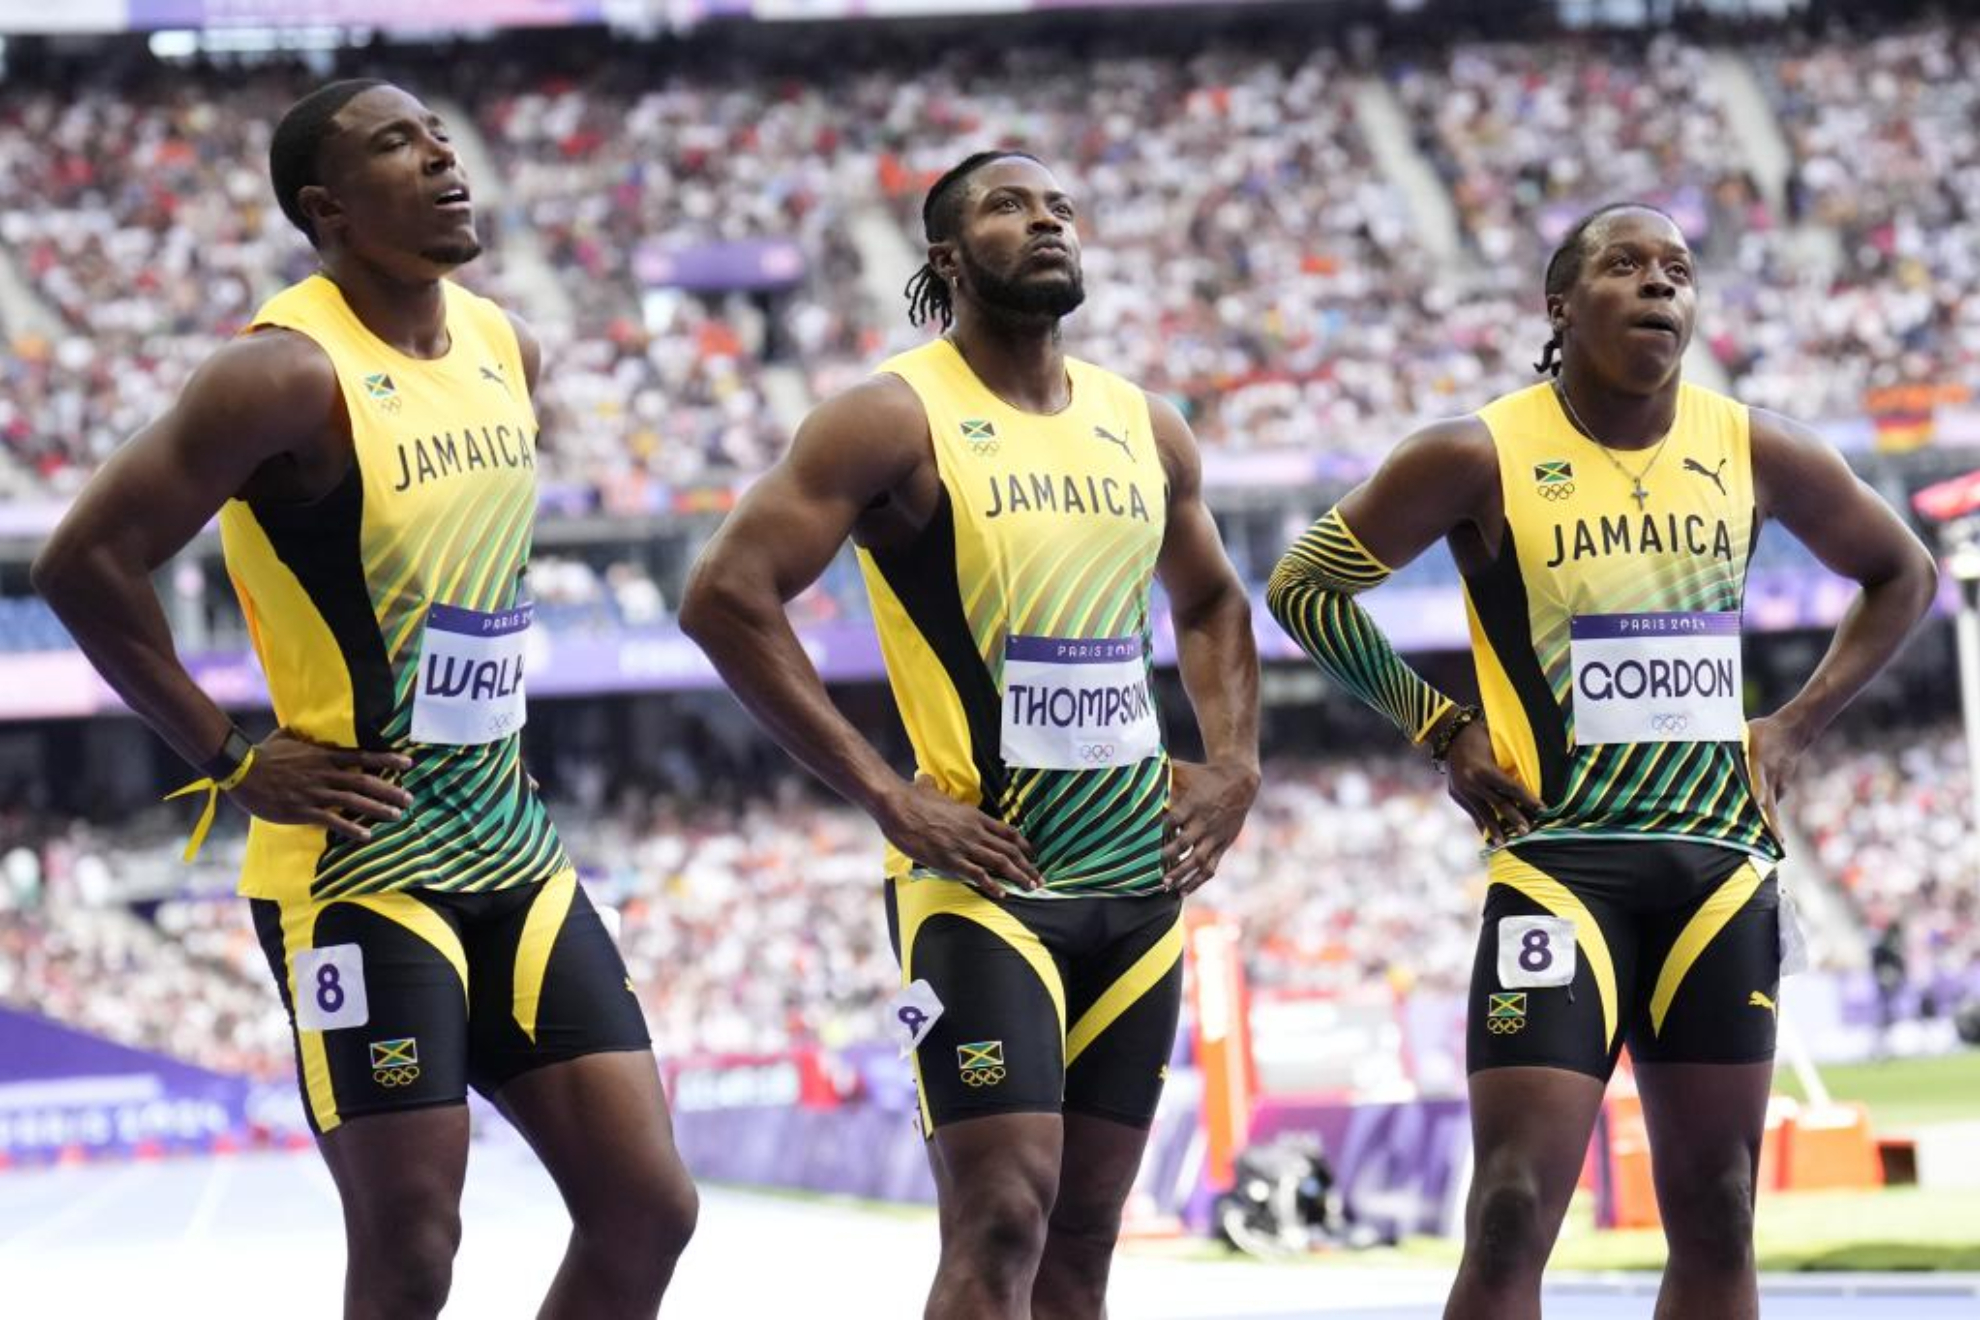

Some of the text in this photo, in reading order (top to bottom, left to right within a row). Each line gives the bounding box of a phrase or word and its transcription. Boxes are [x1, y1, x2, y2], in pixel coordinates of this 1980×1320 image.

[394, 425, 534, 492] JAMAICA
[985, 473, 1149, 523] JAMAICA
[1547, 513, 1732, 568] JAMAICA
[482, 613, 519, 631] PARIS
[1620, 619, 1665, 631] PARIS
[1056, 645, 1102, 658] PARIS
[1579, 658, 1734, 701] GORDON
[1009, 681, 1149, 728] THOMPSON
[1518, 928, 1553, 972] 8
[316, 963, 344, 1013] 8
